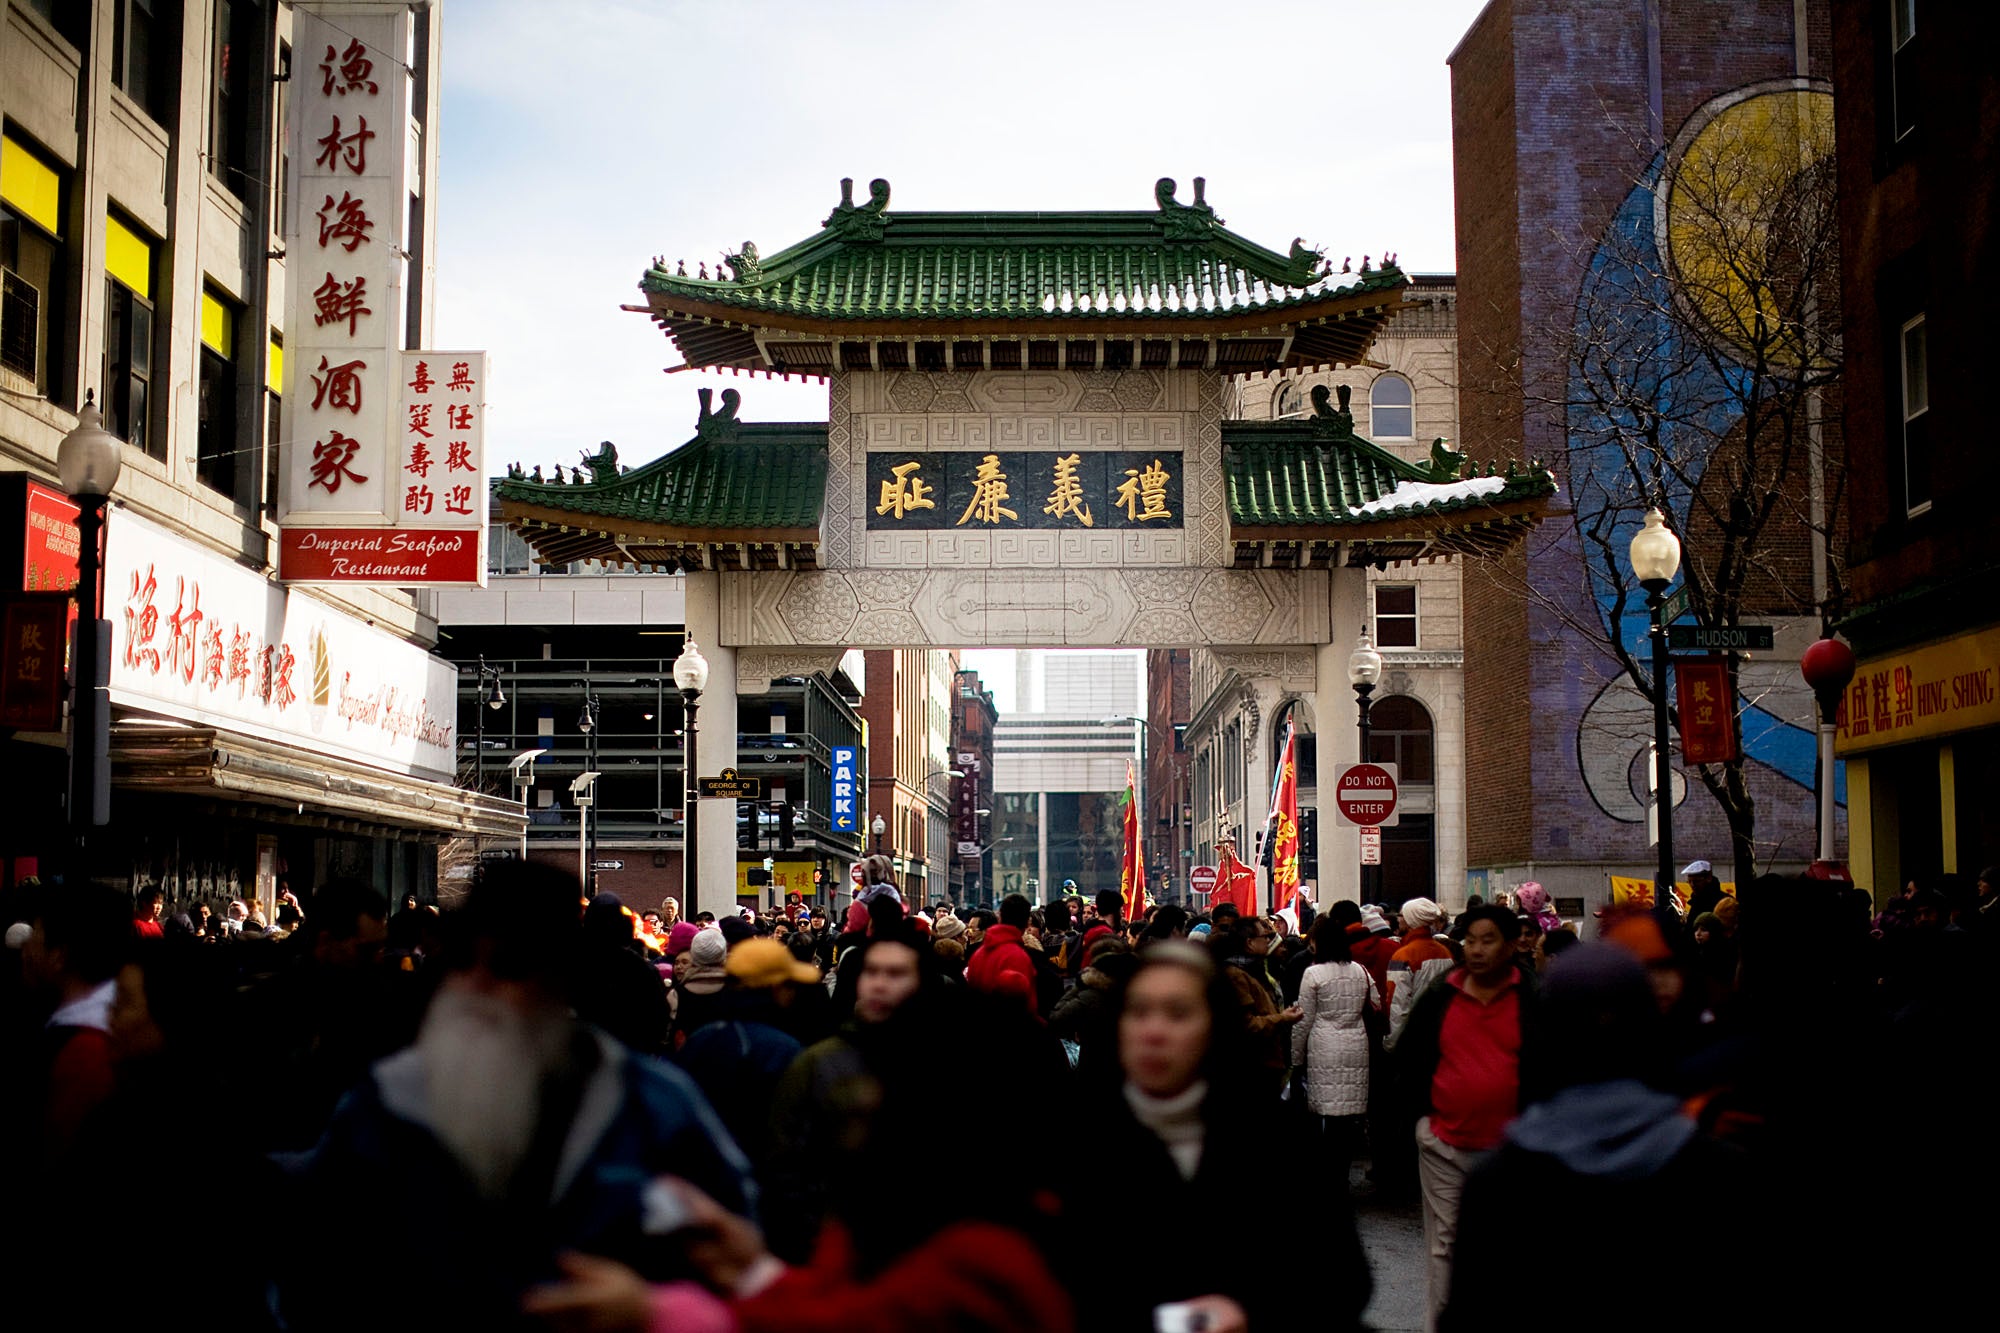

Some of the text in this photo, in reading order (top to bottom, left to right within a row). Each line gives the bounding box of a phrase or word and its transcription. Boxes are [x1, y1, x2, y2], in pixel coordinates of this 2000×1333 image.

[308, 38, 378, 494] 漁村海鮮酒家
[404, 360, 436, 516] 喜筵壽酌
[444, 361, 478, 516] 無任歡迎
[298, 533, 463, 557] Imperial Seafood
[330, 558, 428, 577] Restaurant
[123, 562, 297, 712] 漁村海鮮酒家
[1696, 629, 1769, 647] HUDSON ST
[1692, 680, 1717, 726] 歡迎
[1917, 667, 1994, 717] HING SHING
[835, 750, 852, 813] PARK
[1345, 776, 1387, 786] DO NOT
[1349, 804, 1384, 814] ENTER
[737, 871, 809, 888] 門酒樓
